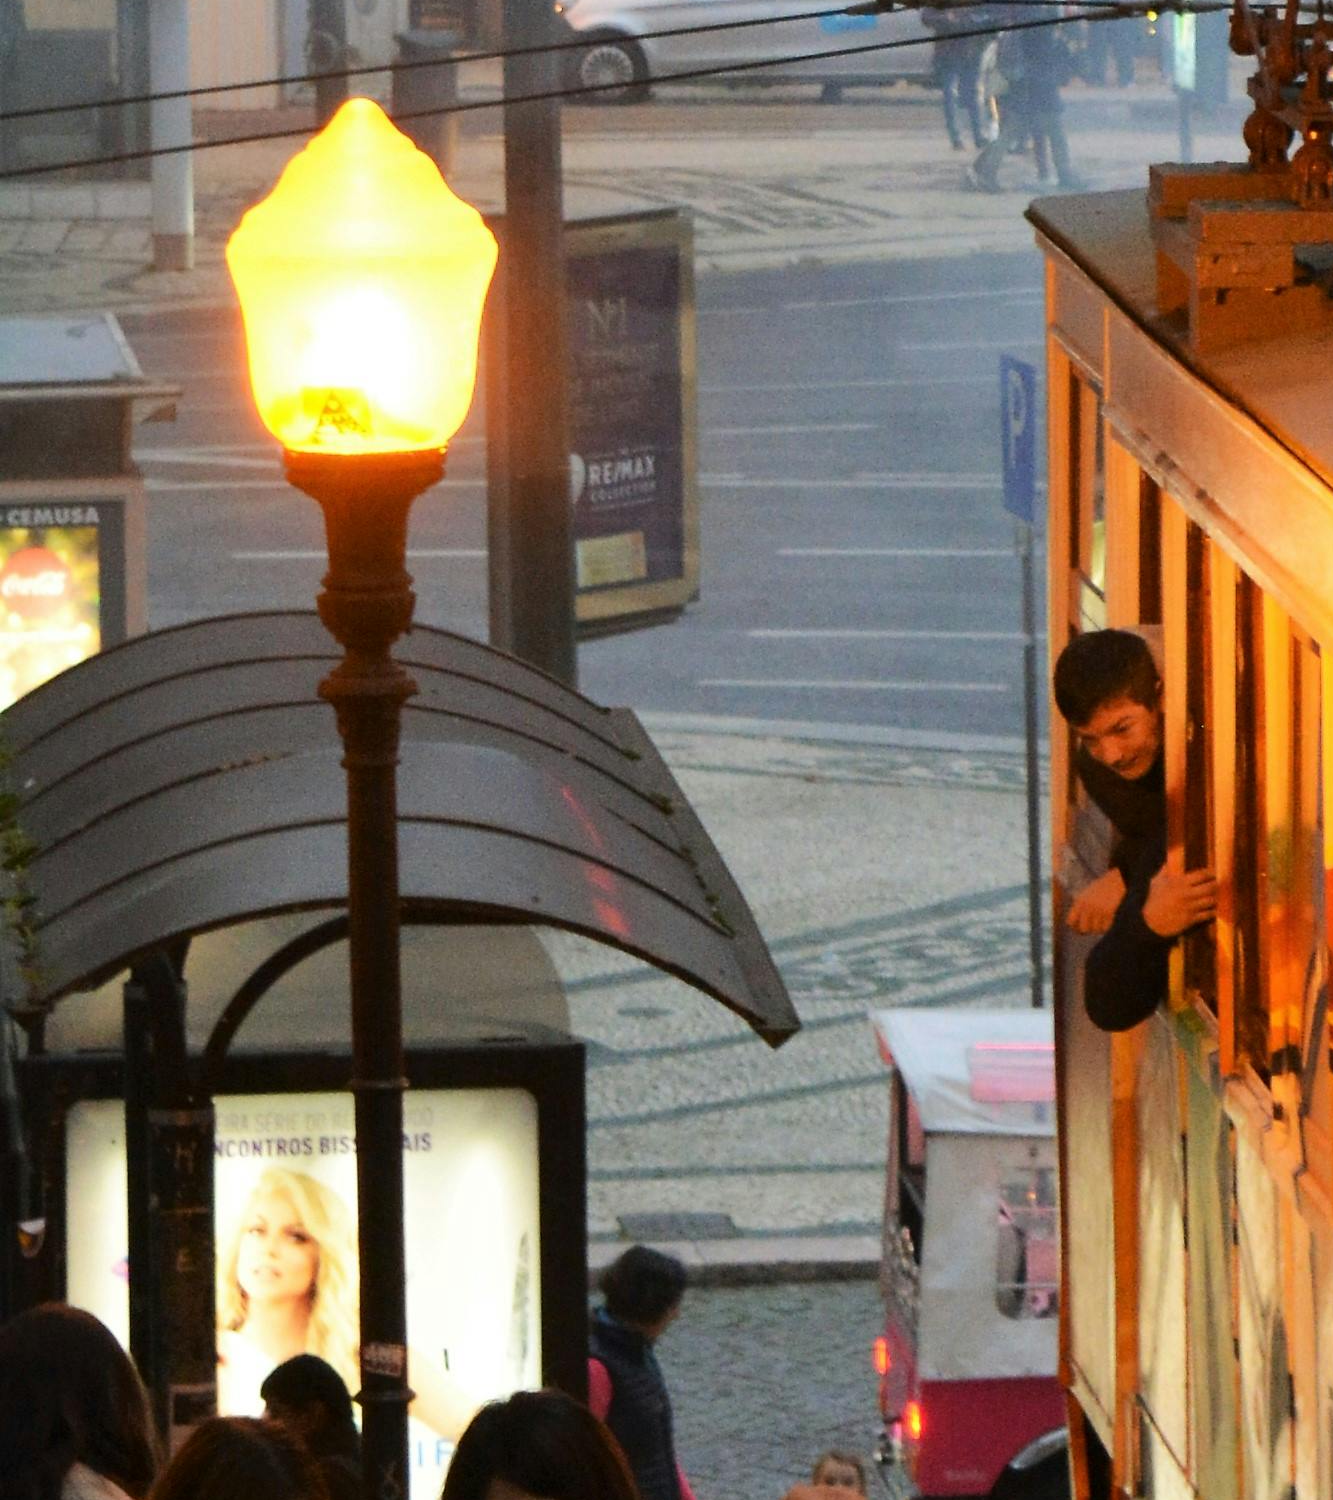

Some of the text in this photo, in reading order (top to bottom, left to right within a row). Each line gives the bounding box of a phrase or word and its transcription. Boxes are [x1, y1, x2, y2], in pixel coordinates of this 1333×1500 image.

[1008, 369, 1026, 470] P
[588, 456, 656, 486] RE/MAX
[8, 507, 100, 525] CEMUSA
[214, 1137, 312, 1158] NCONTROS
